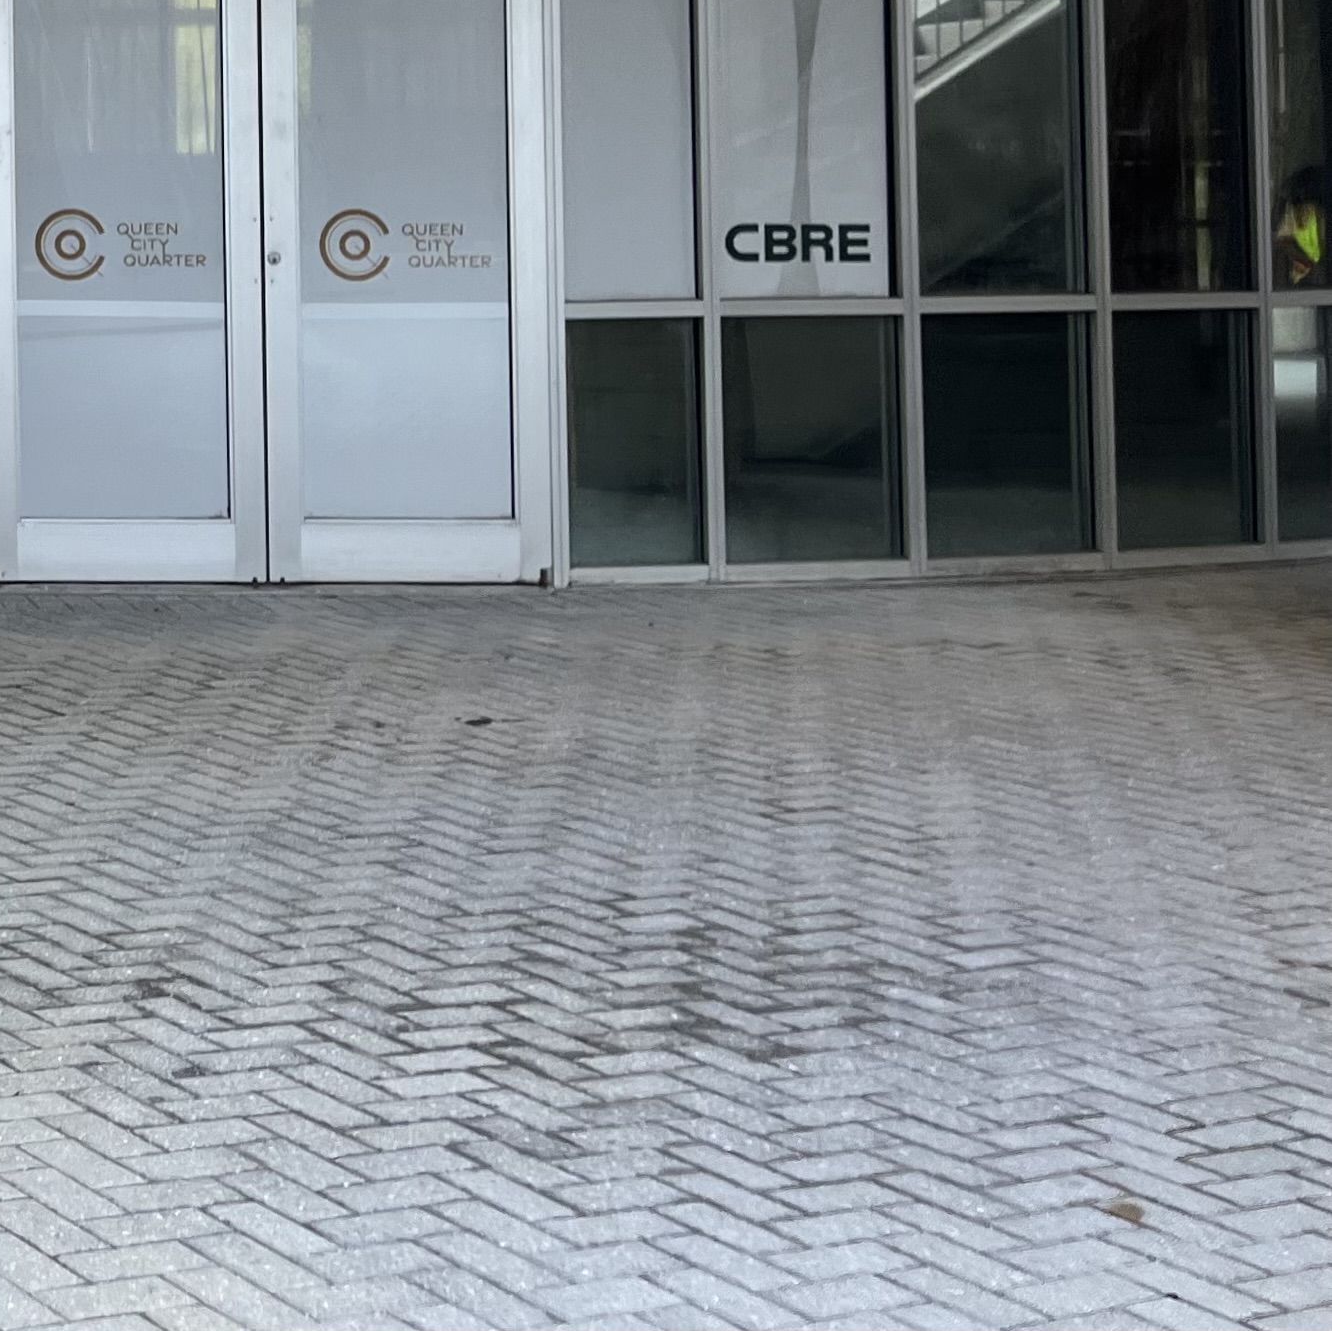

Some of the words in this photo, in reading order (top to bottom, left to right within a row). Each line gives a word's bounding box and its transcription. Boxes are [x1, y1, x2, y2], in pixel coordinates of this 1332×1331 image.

[116, 222, 178, 236] QUEEN
[401, 222, 464, 237] QUEEN
[131, 238, 169, 252] CITY
[415, 239, 454, 253] CITY
[724, 223, 871, 263] CBRE
[123, 254, 207, 268] QUARTER
[407, 254, 492, 269] QUARTER
